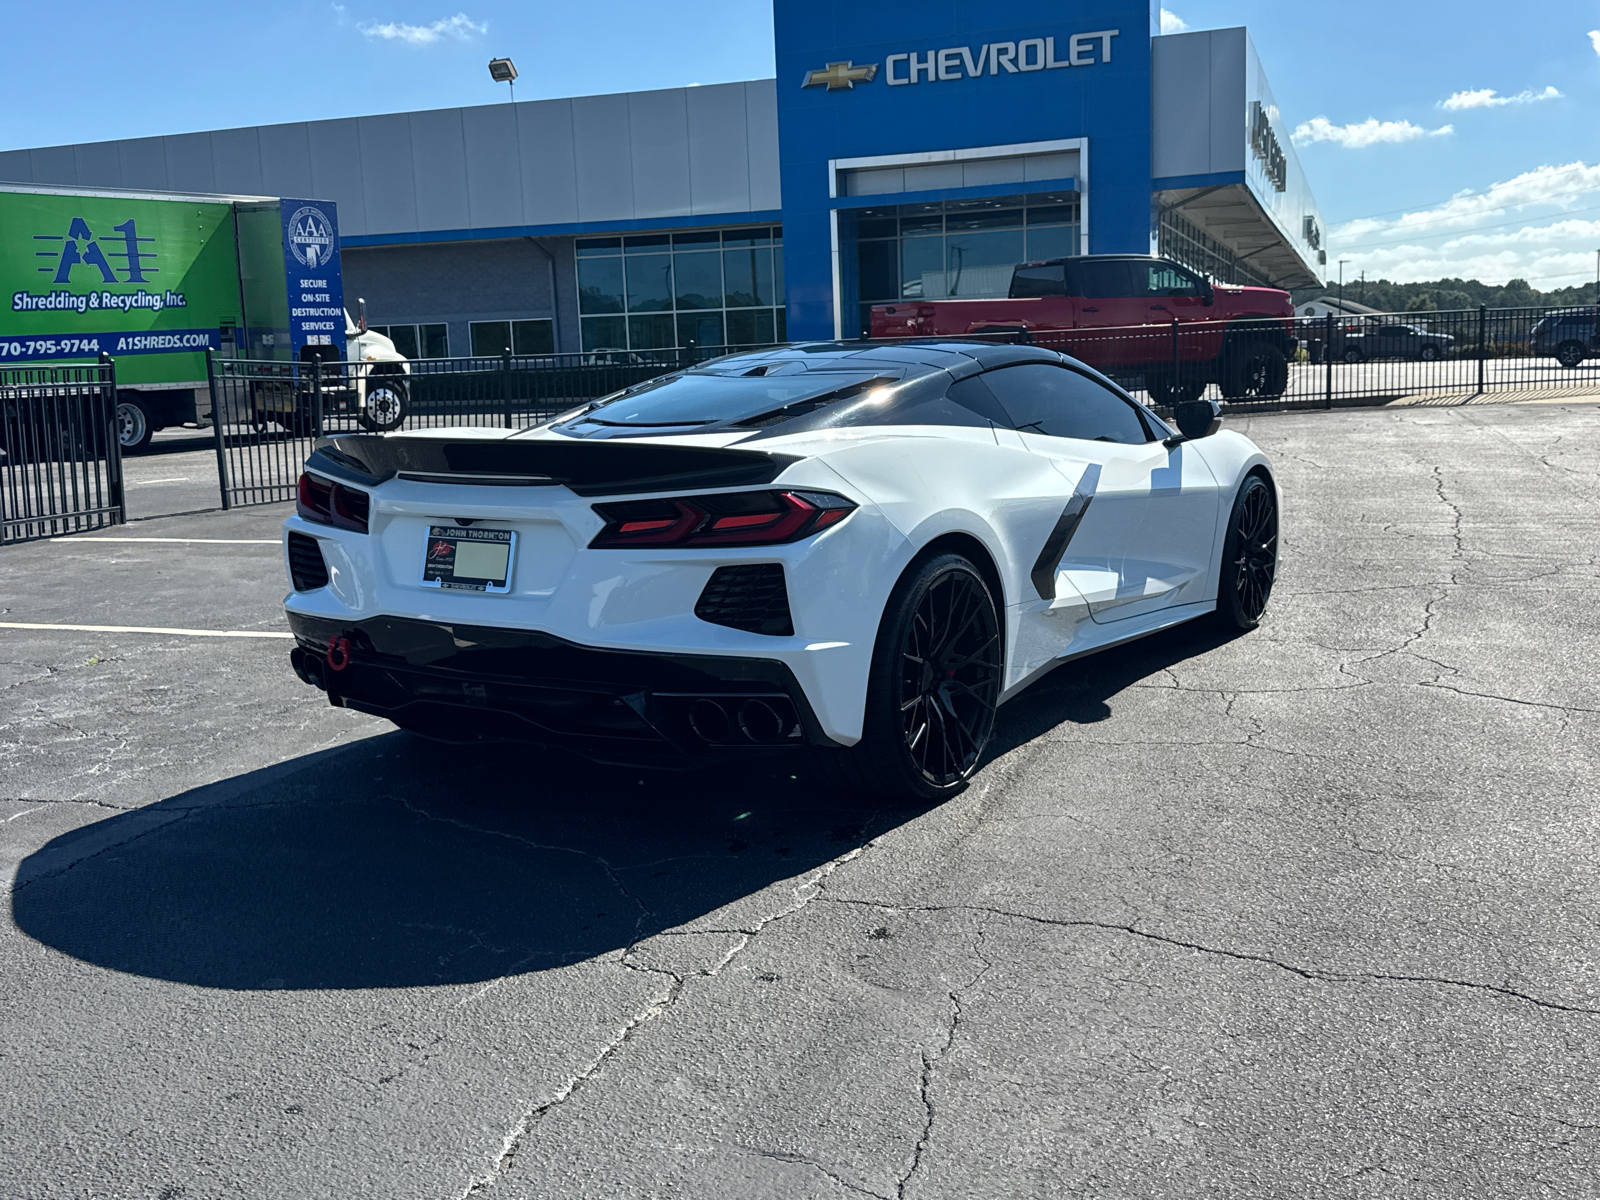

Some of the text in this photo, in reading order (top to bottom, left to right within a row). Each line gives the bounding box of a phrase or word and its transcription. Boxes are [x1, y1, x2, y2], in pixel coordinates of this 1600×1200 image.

[886, 29, 1119, 86] CHEVROLET
[295, 215, 327, 236] AAA
[53, 217, 150, 283] A1
[300, 279, 327, 288] SECURE
[14, 292, 186, 312] Shredding & Recycling, Inc.
[301, 293, 330, 302] ON-SITE
[292, 307, 341, 316] DESTRUCTION
[301, 321, 334, 330] SERVICES
[117, 334, 209, 350] A1SHREDS.COM
[446, 528, 510, 540] JOHN THORNTON
